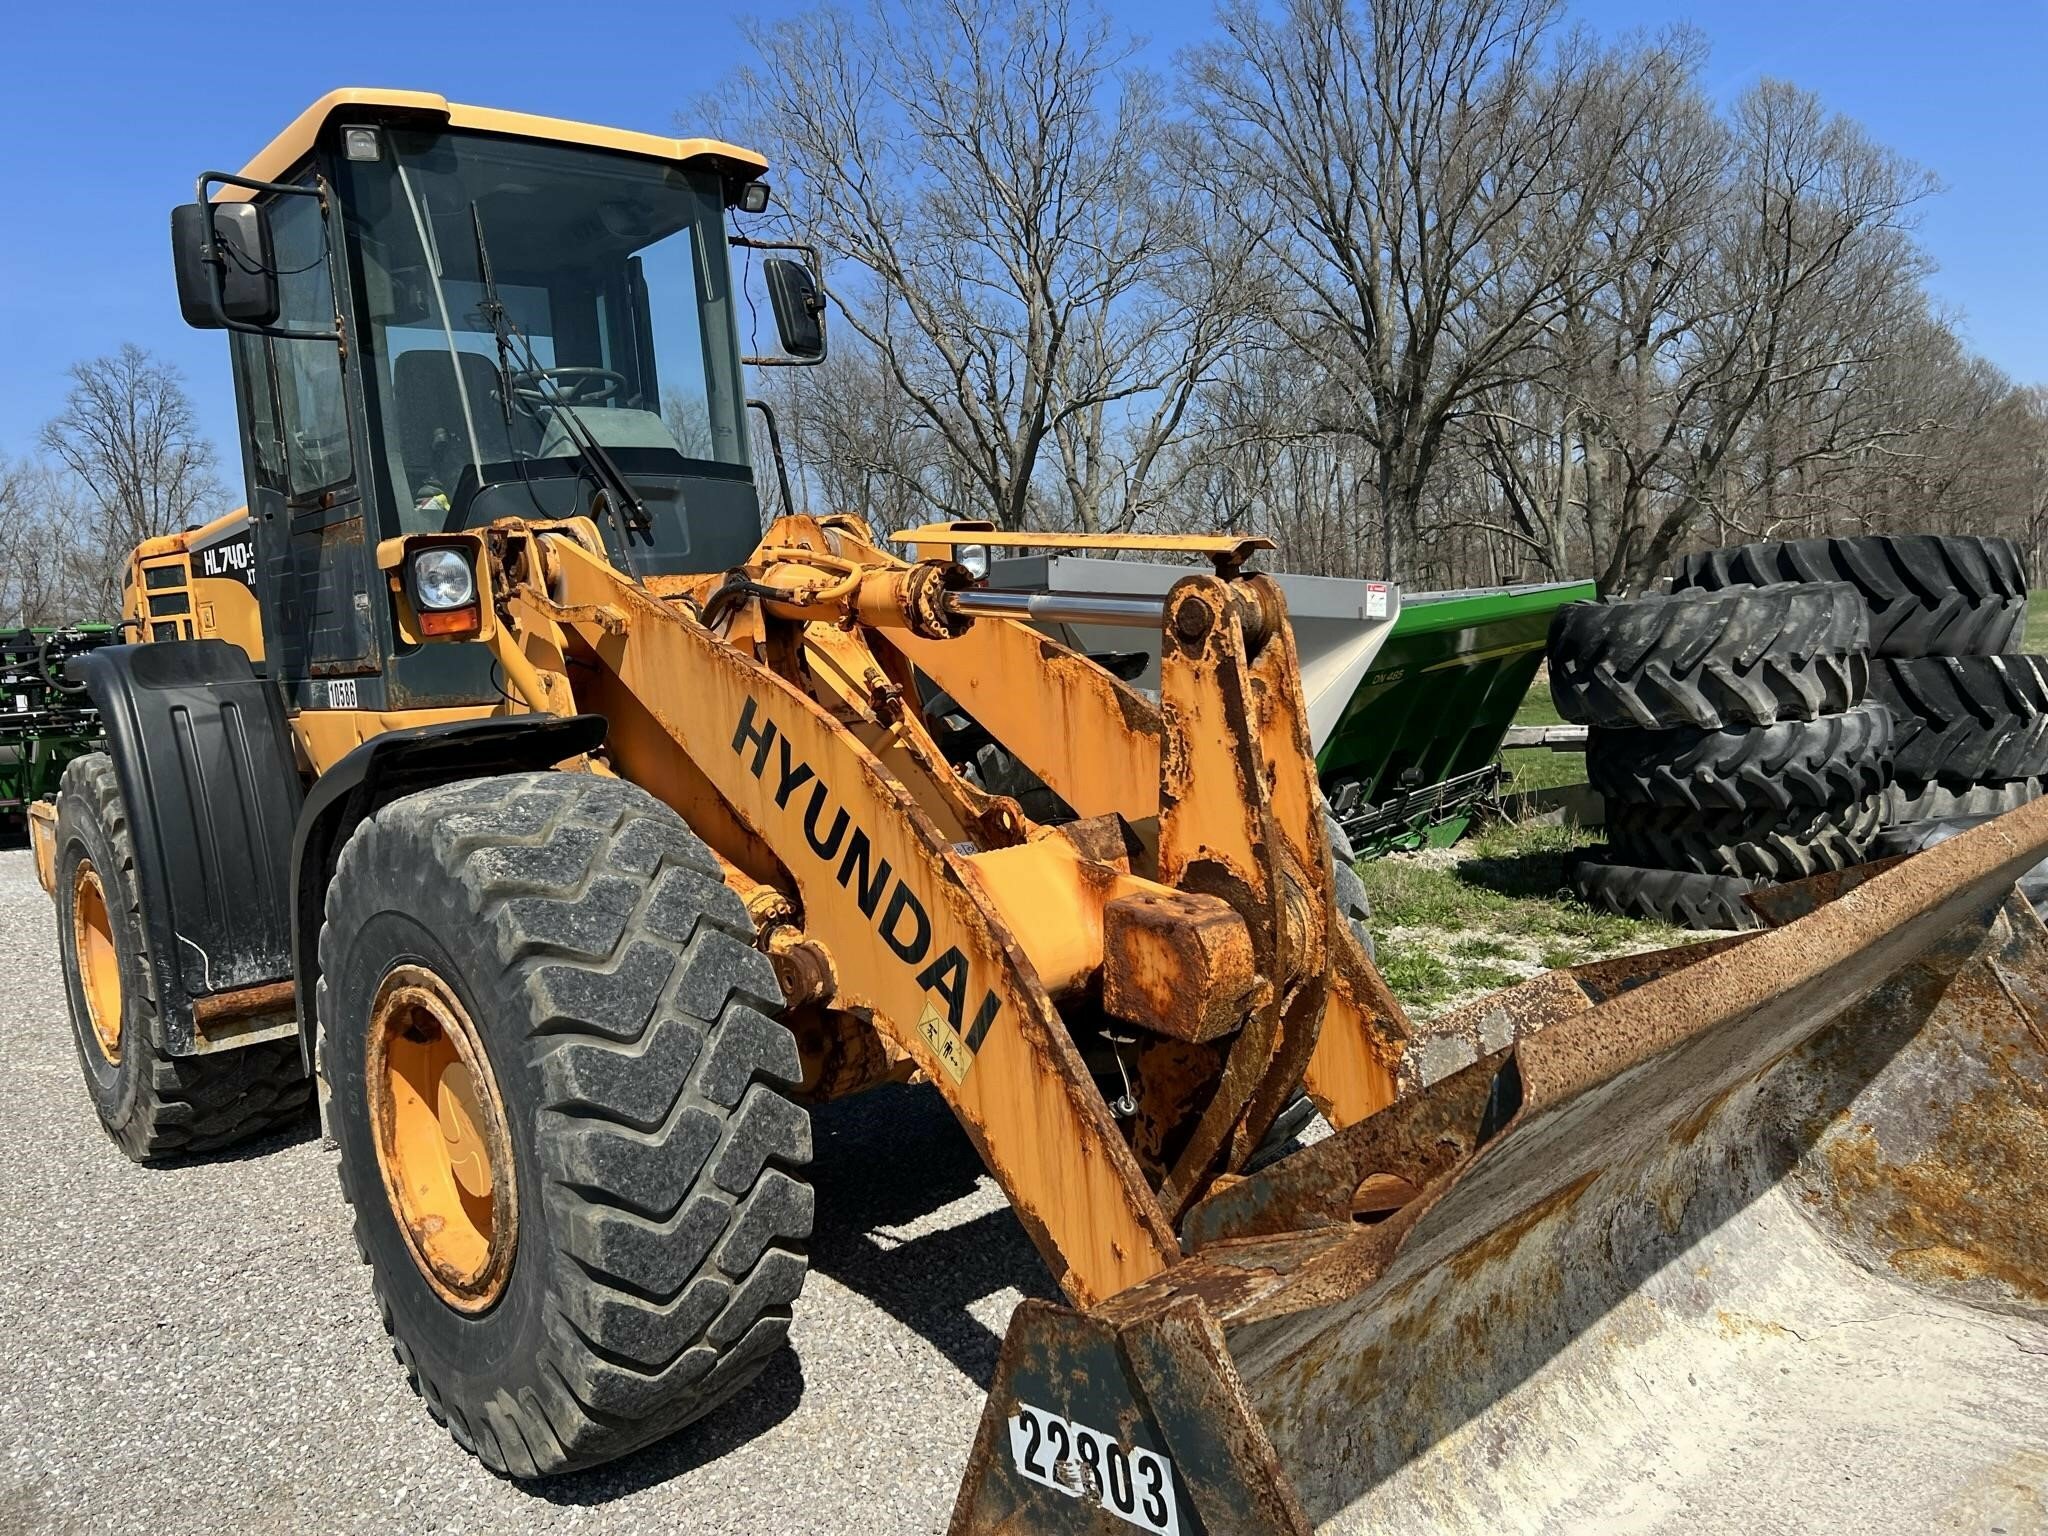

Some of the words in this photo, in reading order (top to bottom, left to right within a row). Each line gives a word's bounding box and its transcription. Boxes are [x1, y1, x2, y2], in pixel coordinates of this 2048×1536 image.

[330, 681, 356, 707] 10586
[731, 694, 1002, 1056] HYUNDAI
[1019, 1409, 1169, 1528] 22803
